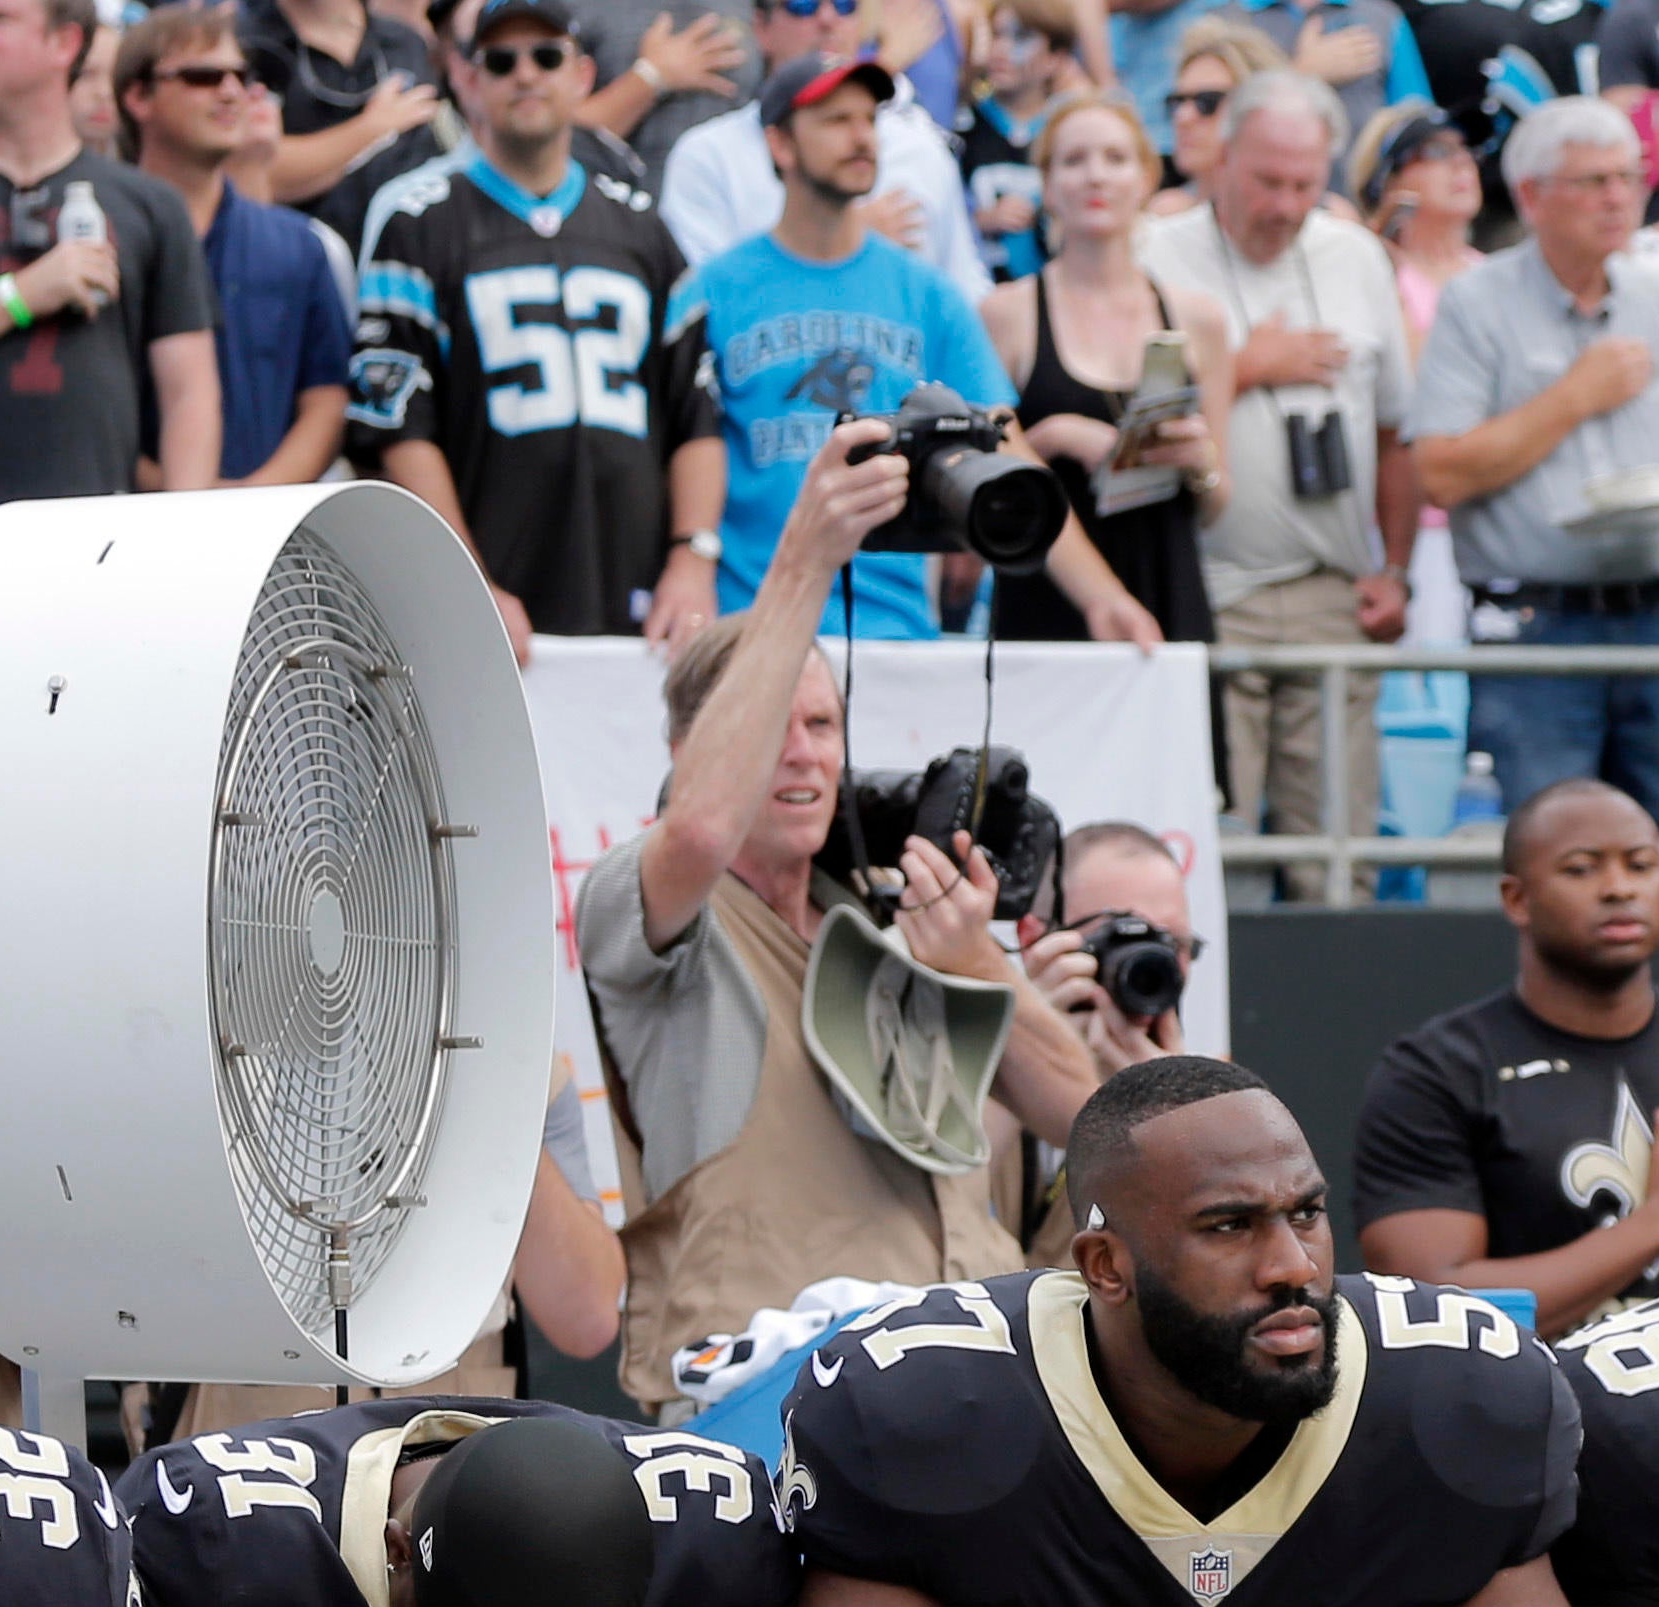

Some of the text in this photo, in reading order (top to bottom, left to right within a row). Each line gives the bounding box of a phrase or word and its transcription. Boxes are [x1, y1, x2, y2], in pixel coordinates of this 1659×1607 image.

[463, 263, 653, 440] 52
[1357, 1272, 1520, 1358] 5
[191, 1433, 323, 1523] 31
[1196, 1572, 1228, 1593] NFL
